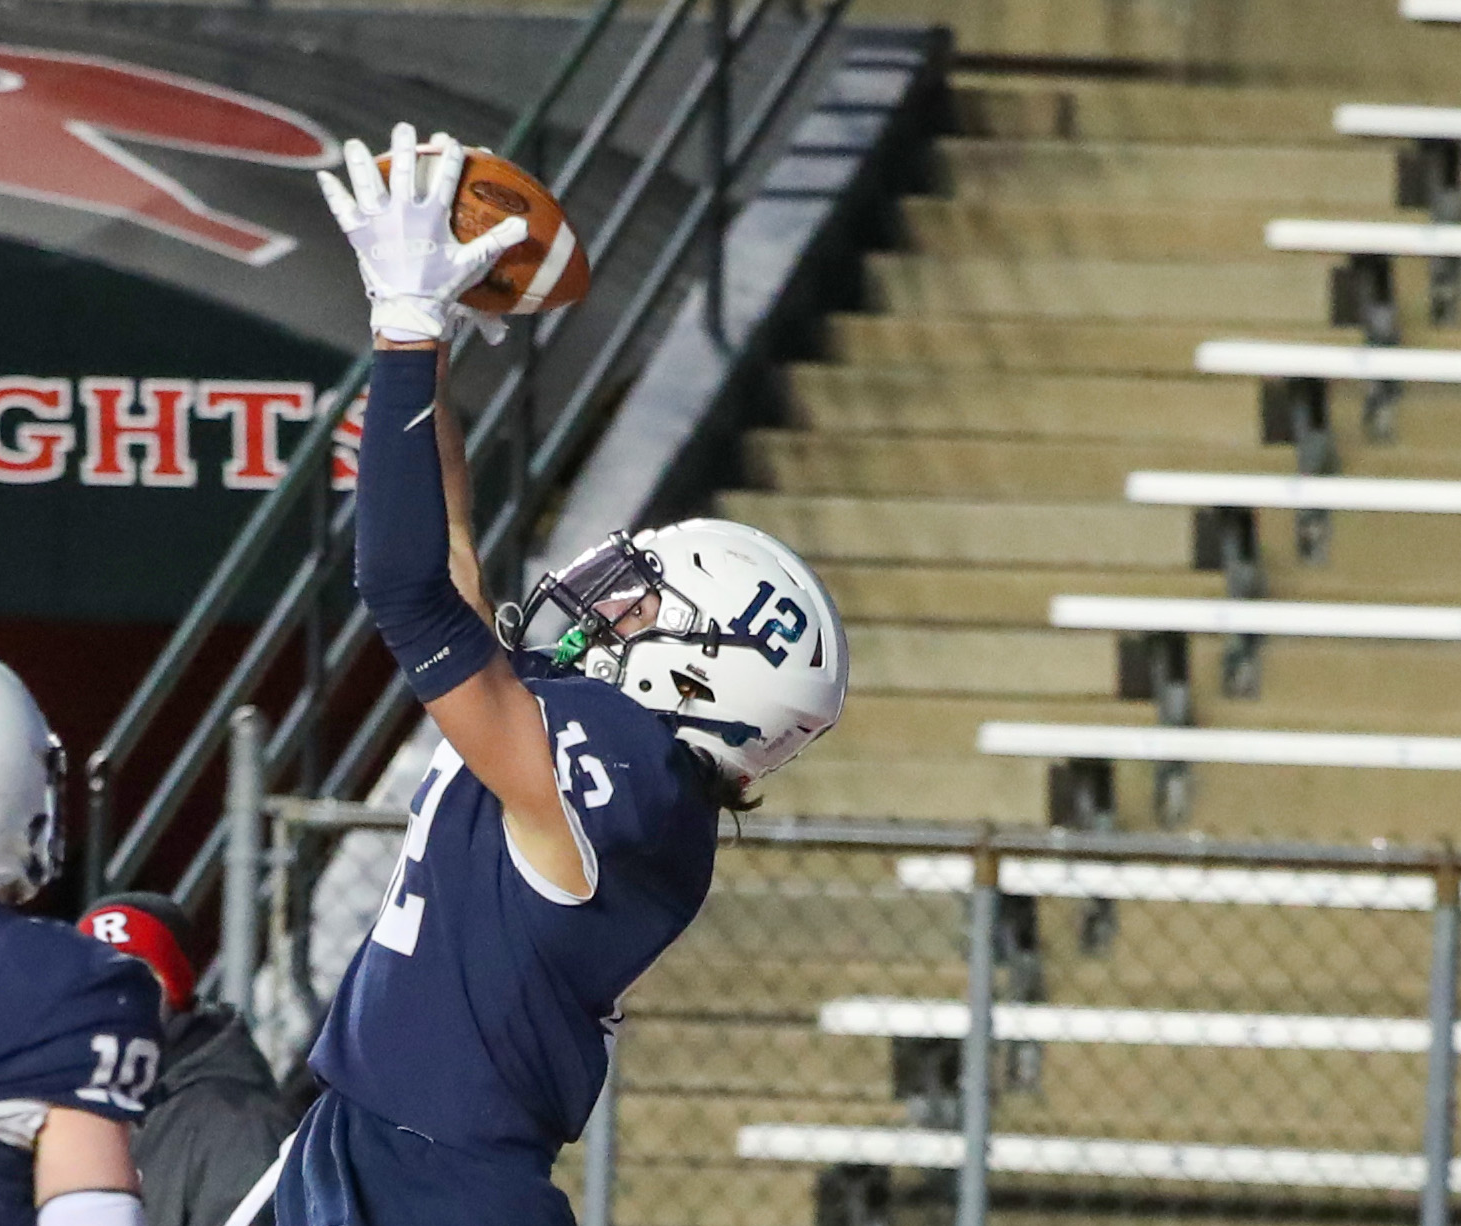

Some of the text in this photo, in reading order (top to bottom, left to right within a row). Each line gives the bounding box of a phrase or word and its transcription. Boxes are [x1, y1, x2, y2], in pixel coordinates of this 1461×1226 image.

[728, 580, 808, 669] 12
[92, 911, 131, 943] R
[74, 1034, 161, 1112] 10
